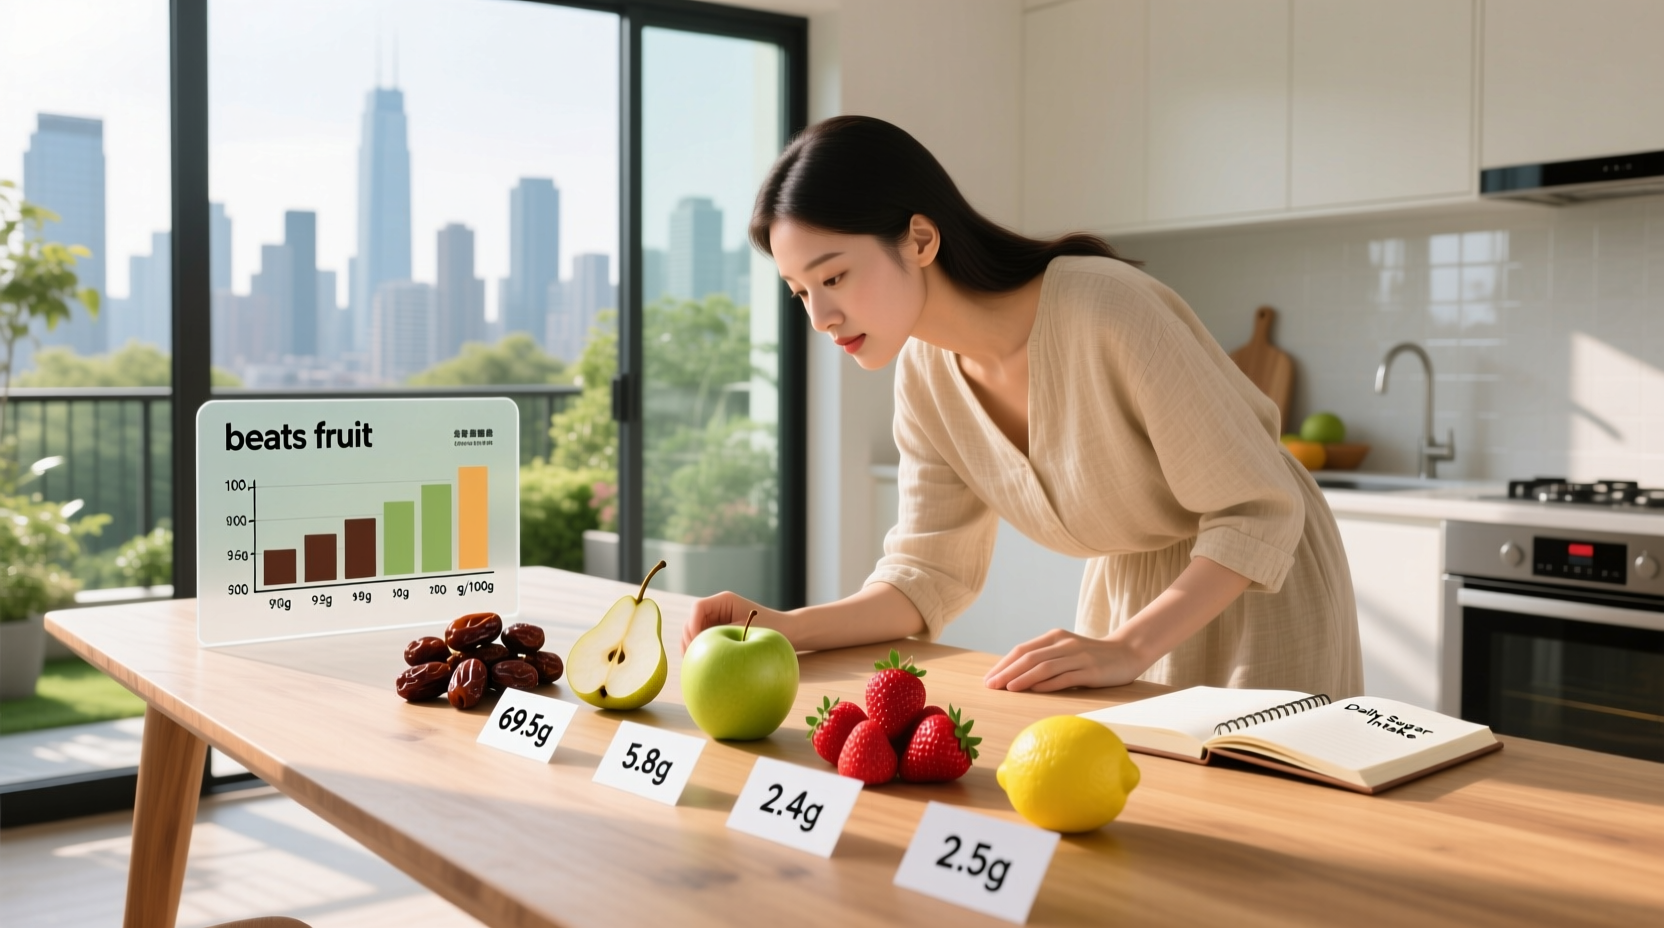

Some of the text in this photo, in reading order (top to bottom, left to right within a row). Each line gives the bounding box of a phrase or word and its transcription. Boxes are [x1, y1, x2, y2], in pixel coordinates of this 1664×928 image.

[225, 421, 373, 451] beats fruit
[457, 581, 494, 596] g/100g
[498, 706, 554, 748] 69.5g
[621, 742, 674, 786] 5.8g
[759, 783, 824, 833] 2.4g
[935, 834, 1012, 892] 2.5g
